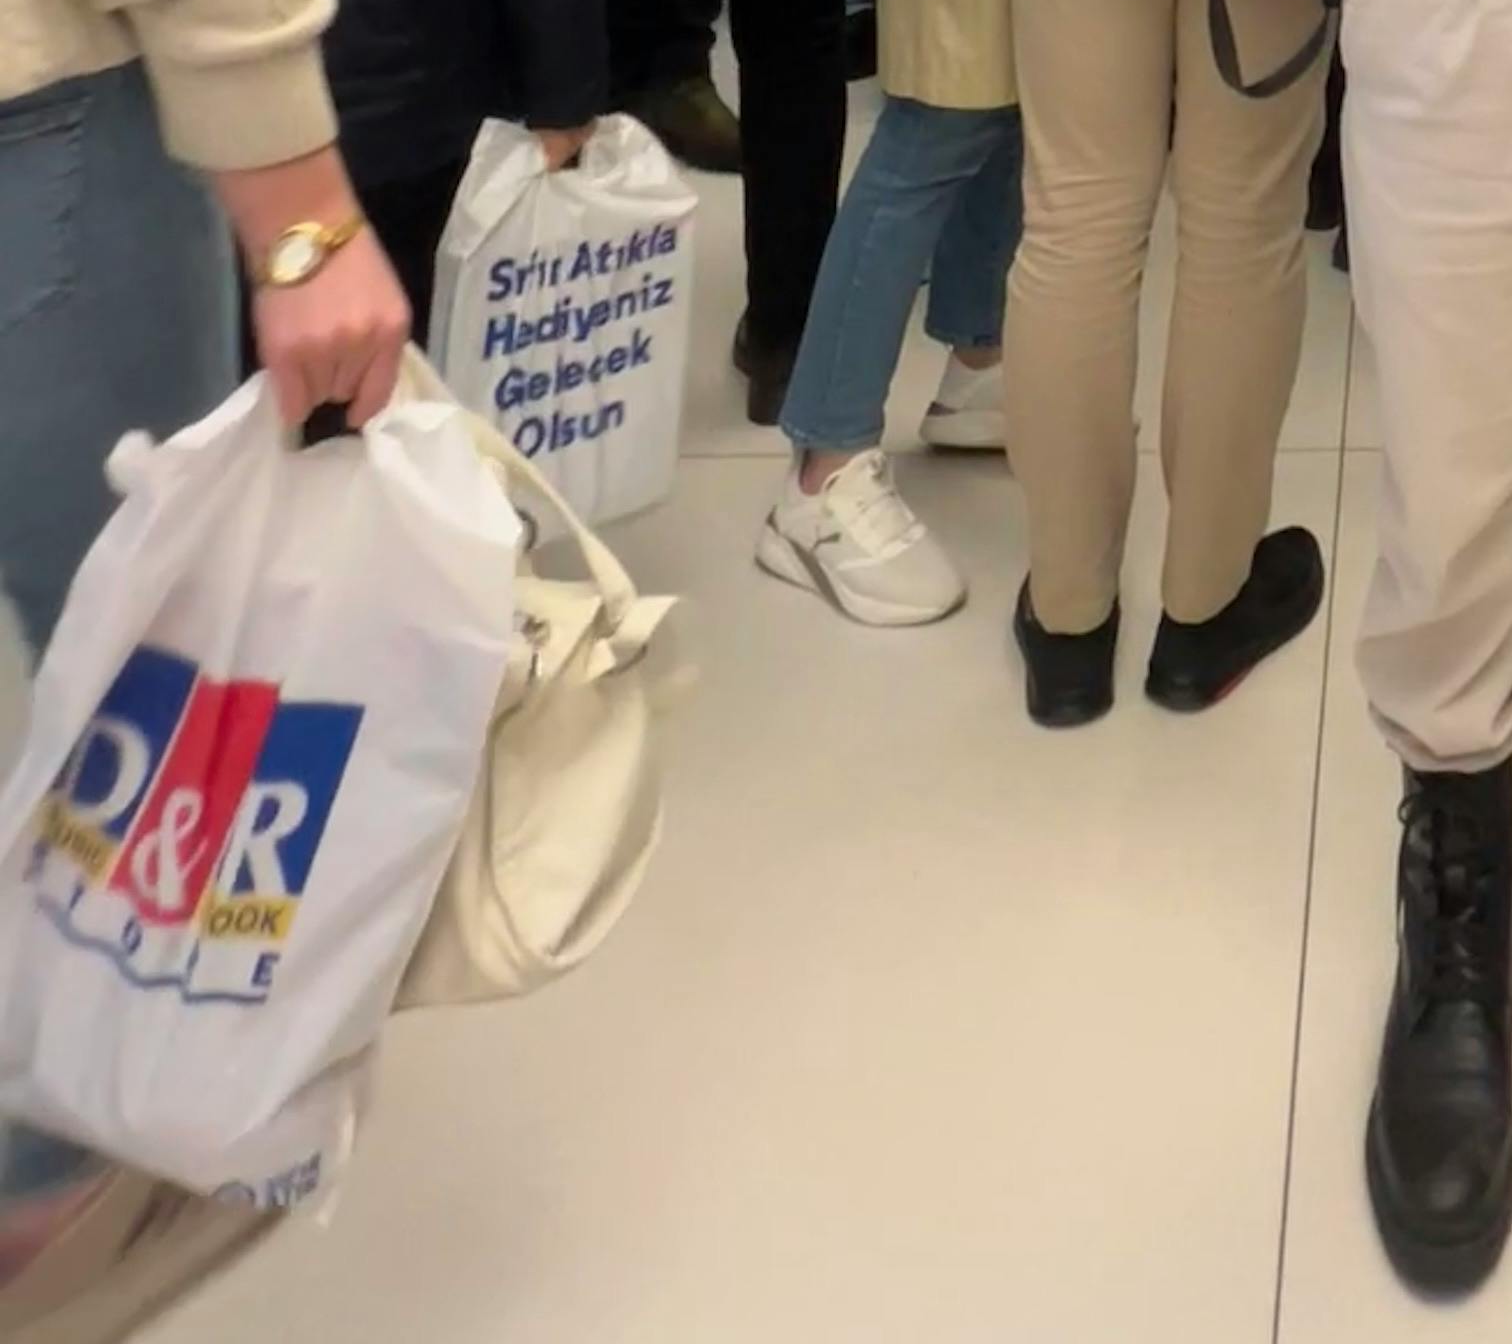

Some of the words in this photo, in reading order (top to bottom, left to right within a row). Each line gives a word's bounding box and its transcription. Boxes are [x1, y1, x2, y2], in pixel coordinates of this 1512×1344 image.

[483, 272, 673, 360] Hediyeniz
[495, 328, 652, 410] Gelecek
[513, 400, 624, 459] Olsun
